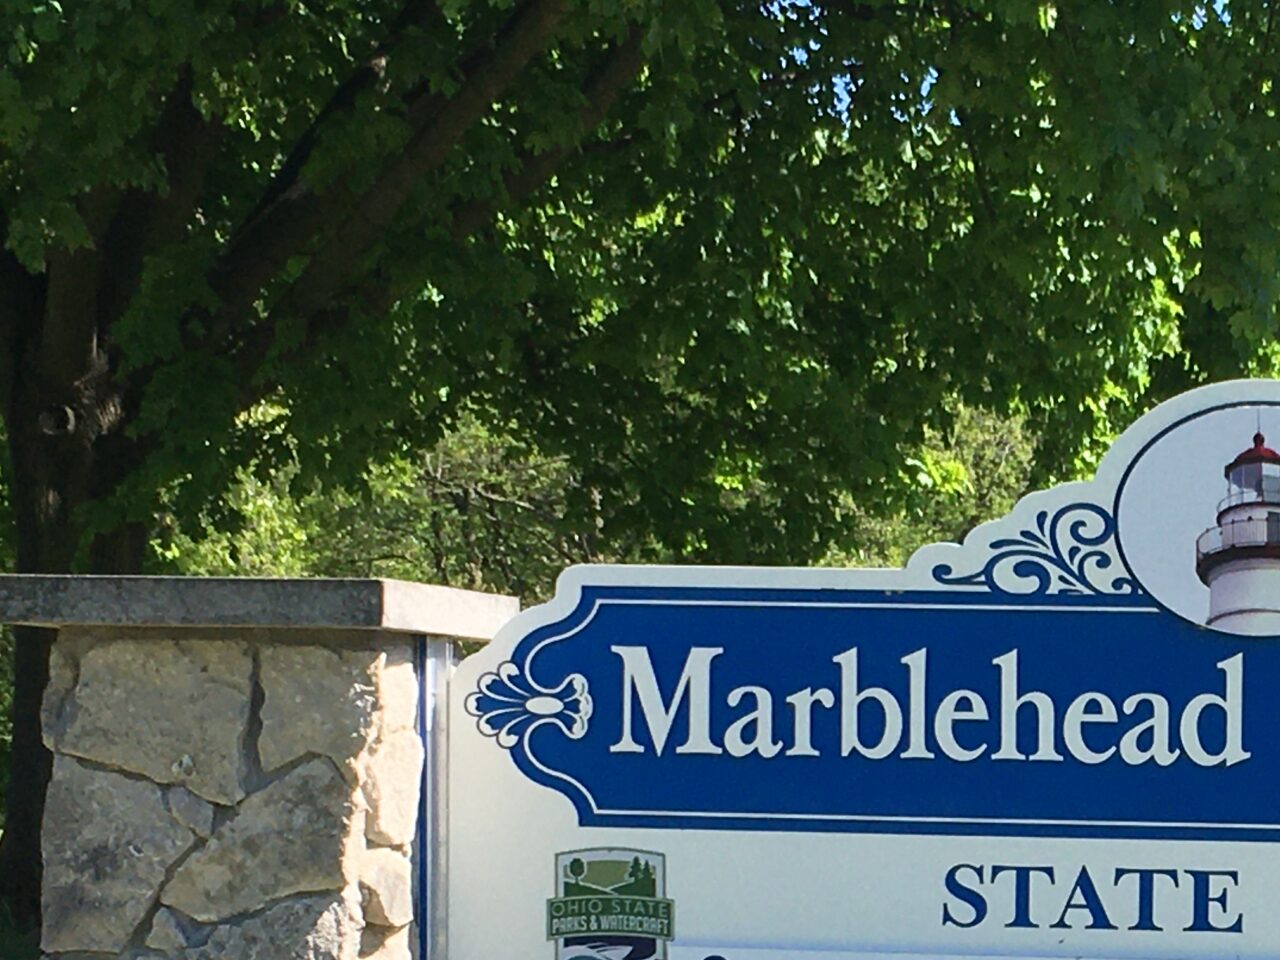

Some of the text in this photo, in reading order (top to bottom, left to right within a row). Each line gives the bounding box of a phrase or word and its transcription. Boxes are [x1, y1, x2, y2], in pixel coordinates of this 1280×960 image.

[609, 645, 1252, 767] Marblehead
[552, 899, 669, 918] OHIO STATE
[941, 863, 1244, 934] STATE
[552, 915, 669, 935] PARKS & WATERCRAFT
